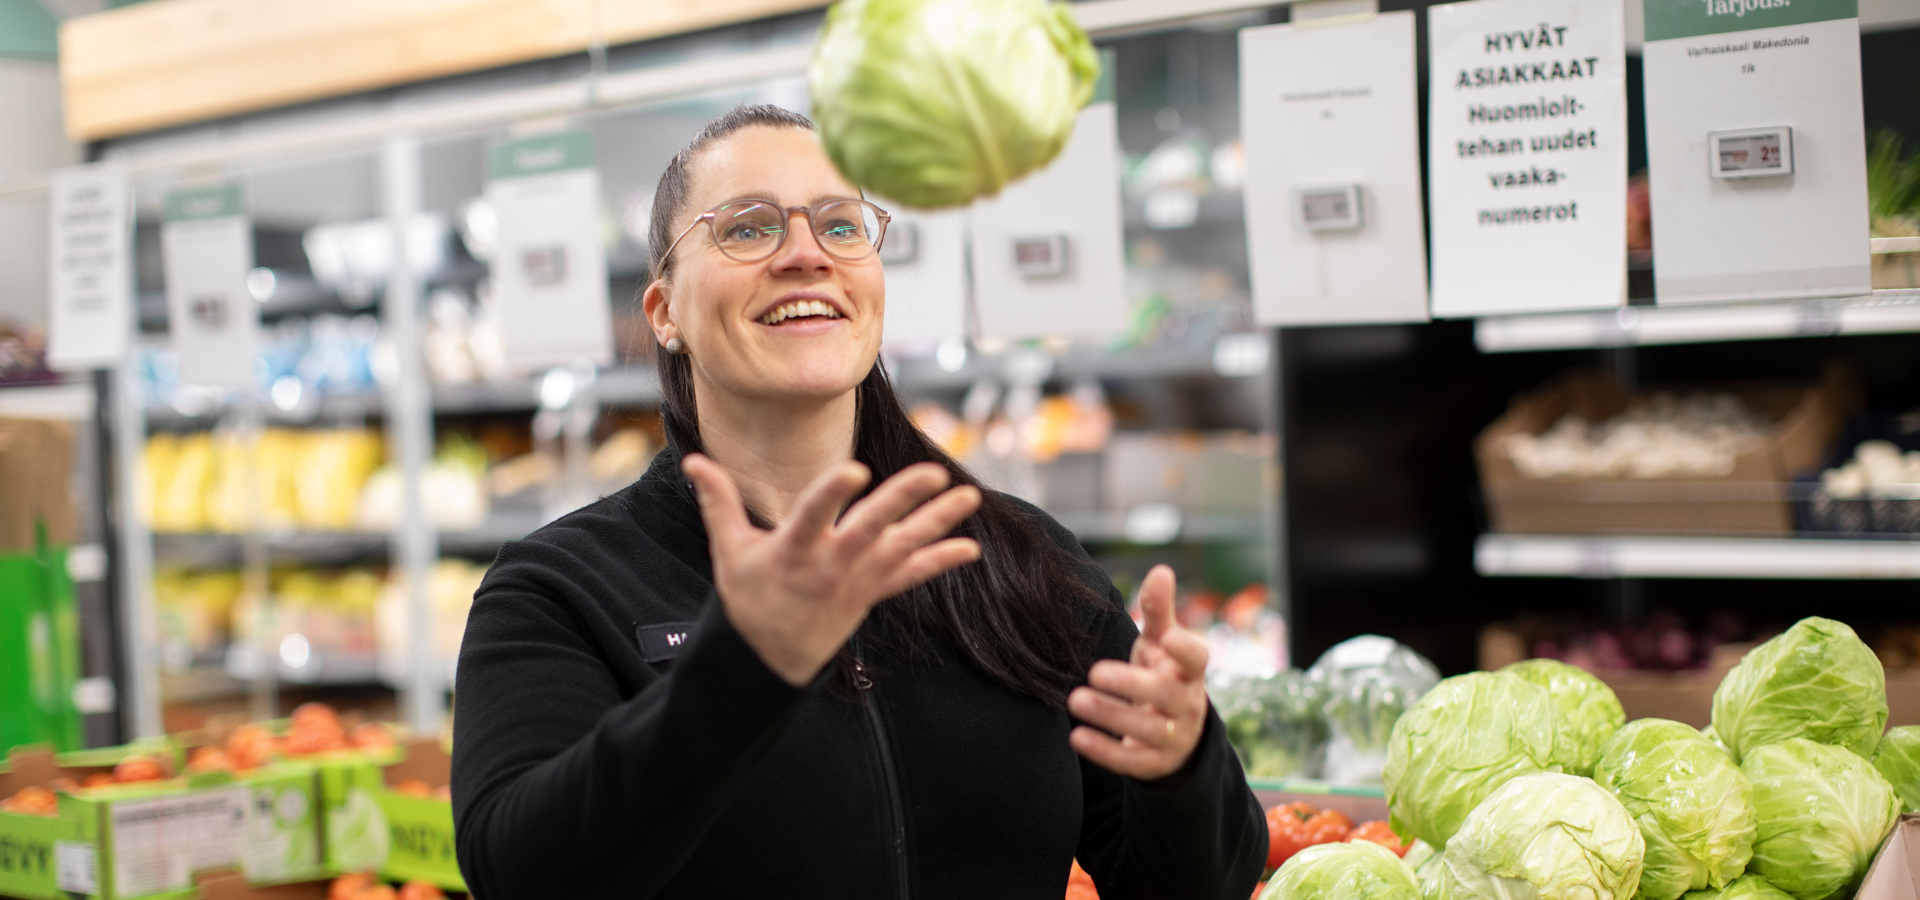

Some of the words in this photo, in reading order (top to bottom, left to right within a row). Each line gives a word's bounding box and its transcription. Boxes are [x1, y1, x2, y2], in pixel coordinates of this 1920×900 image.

[1484, 23, 1567, 52] HYVÄT
[1687, 42, 1749, 57] Varhaiskaali
[1752, 35, 1810, 50] Makedonia
[1456, 56, 1598, 89] ASIAKKAAT
[1468, 94, 1585, 124] Huomioit-
[1456, 136, 1523, 159] tehan
[1531, 128, 1598, 152] uudet
[1488, 165, 1566, 189] vaaka-
[1478, 201, 1578, 225] numerot
